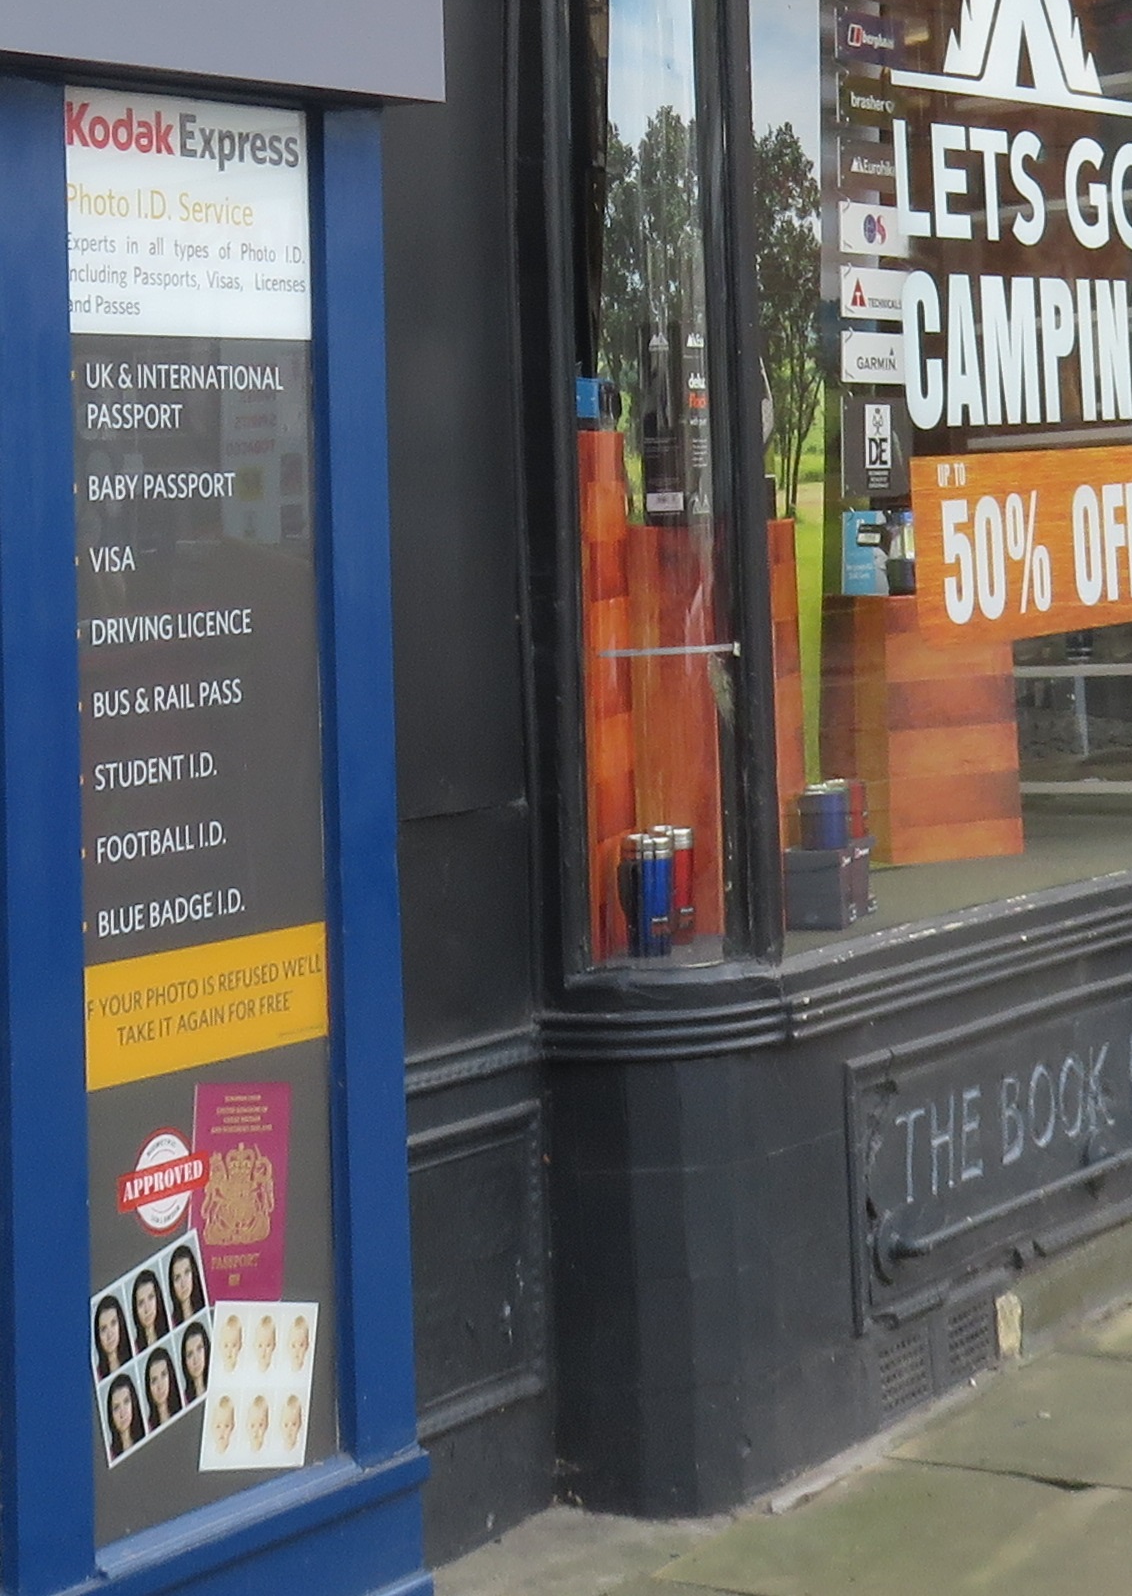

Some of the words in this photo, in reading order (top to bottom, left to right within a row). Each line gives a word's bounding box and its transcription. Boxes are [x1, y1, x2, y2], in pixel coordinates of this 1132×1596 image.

[64, 101, 174, 155] Kodak
[179, 112, 299, 171] Express
[893, 118, 1047, 247] LETS
[66, 183, 129, 218] Photo
[137, 189, 171, 221] I.D.
[179, 193, 254, 226] Service
[126, 236, 138, 254] in
[148, 237, 164, 255] all
[174, 239, 209, 261] types
[219, 242, 231, 259] of
[240, 243, 276, 263] Photo
[69, 264, 127, 288] ncluding
[254, 273, 306, 294] Licenses
[95, 295, 140, 315] Passes
[85, 363, 113, 389] UK
[117, 364, 133, 390] &
[137, 364, 284, 391] INTERNATIONAL
[857, 356, 896, 371] GARMIN
[87, 404, 183, 430] PASSPORT
[868, 437, 888, 466] DE
[88, 475, 139, 501] BABY
[143, 472, 236, 499] PASSPORT
[937, 464, 950, 487] UP
[954, 462, 967, 487] TO
[89, 546, 136, 572] VISA
[940, 490, 1053, 626] 50%
[91, 614, 173, 646] DRIVING
[178, 609, 252, 639] LICENCE
[93, 689, 130, 718] BUS
[135, 687, 151, 714] &
[154, 684, 195, 713] RAIL
[199, 678, 243, 707] PASS
[94, 755, 184, 791] STUDENT
[189, 751, 218, 780] I.D.
[96, 825, 195, 864] FOOTBALL
[199, 820, 227, 850] I.D.
[98, 903, 146, 939] BLUE
[149, 892, 214, 928] BADGE
[217, 887, 246, 917] I.D.
[98, 990, 143, 1019] YOUR
[146, 979, 199, 1009] PHOTO
[202, 978, 215, 997] IS
[219, 962, 279, 992] REFUSED
[282, 954, 322, 980] WE'LL
[117, 1016, 155, 1047] TAKE
[159, 1017, 172, 1038] IT
[176, 1008, 225, 1035] AGAIN
[228, 998, 256, 1023] FOR
[896, 1085, 983, 1203] THE
[1001, 1041, 1115, 1166] BOOK
[123, 1159, 203, 1203] APPROVED
